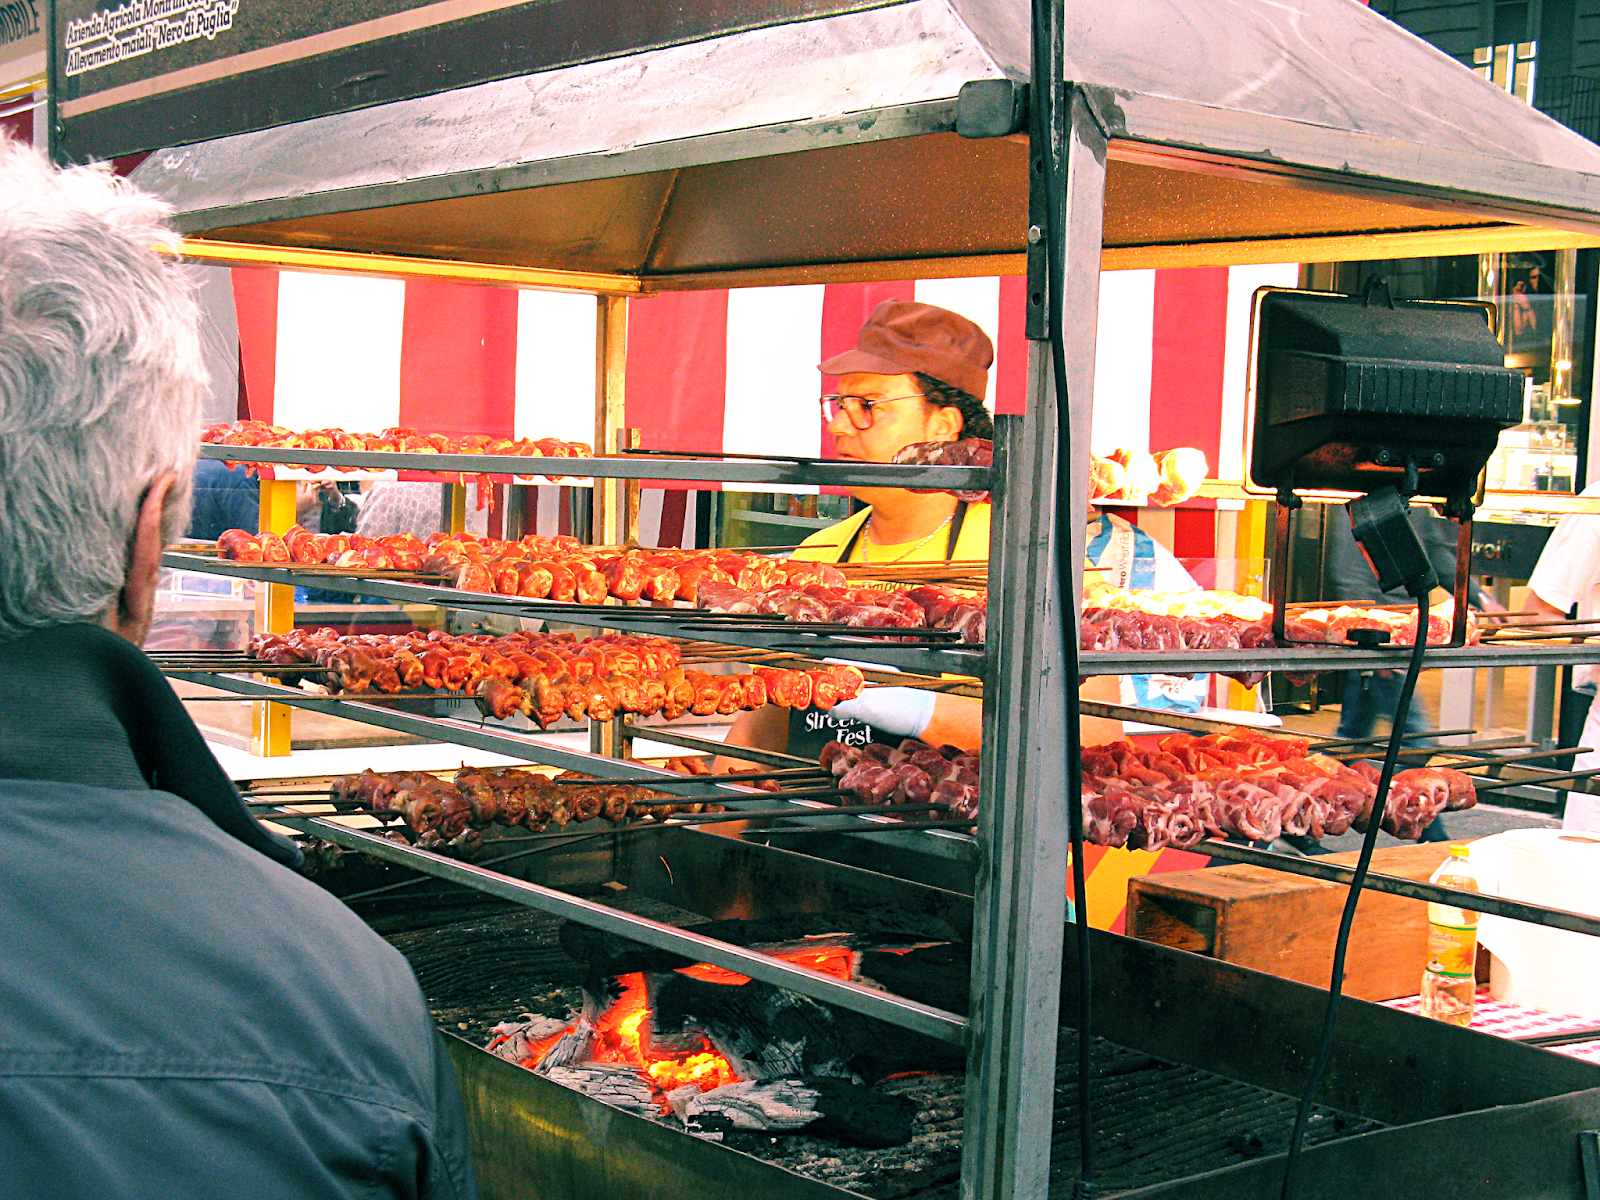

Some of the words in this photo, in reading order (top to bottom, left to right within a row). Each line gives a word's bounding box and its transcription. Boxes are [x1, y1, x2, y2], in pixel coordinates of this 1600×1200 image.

[66, 16, 103, 47] Azienda
[103, 3, 142, 37] Agricola
[66, 42, 121, 74] Allevamento
[121, 28, 152, 56] maiali
[184, 13, 195, 37] di
[836, 725, 874, 746] Fest
